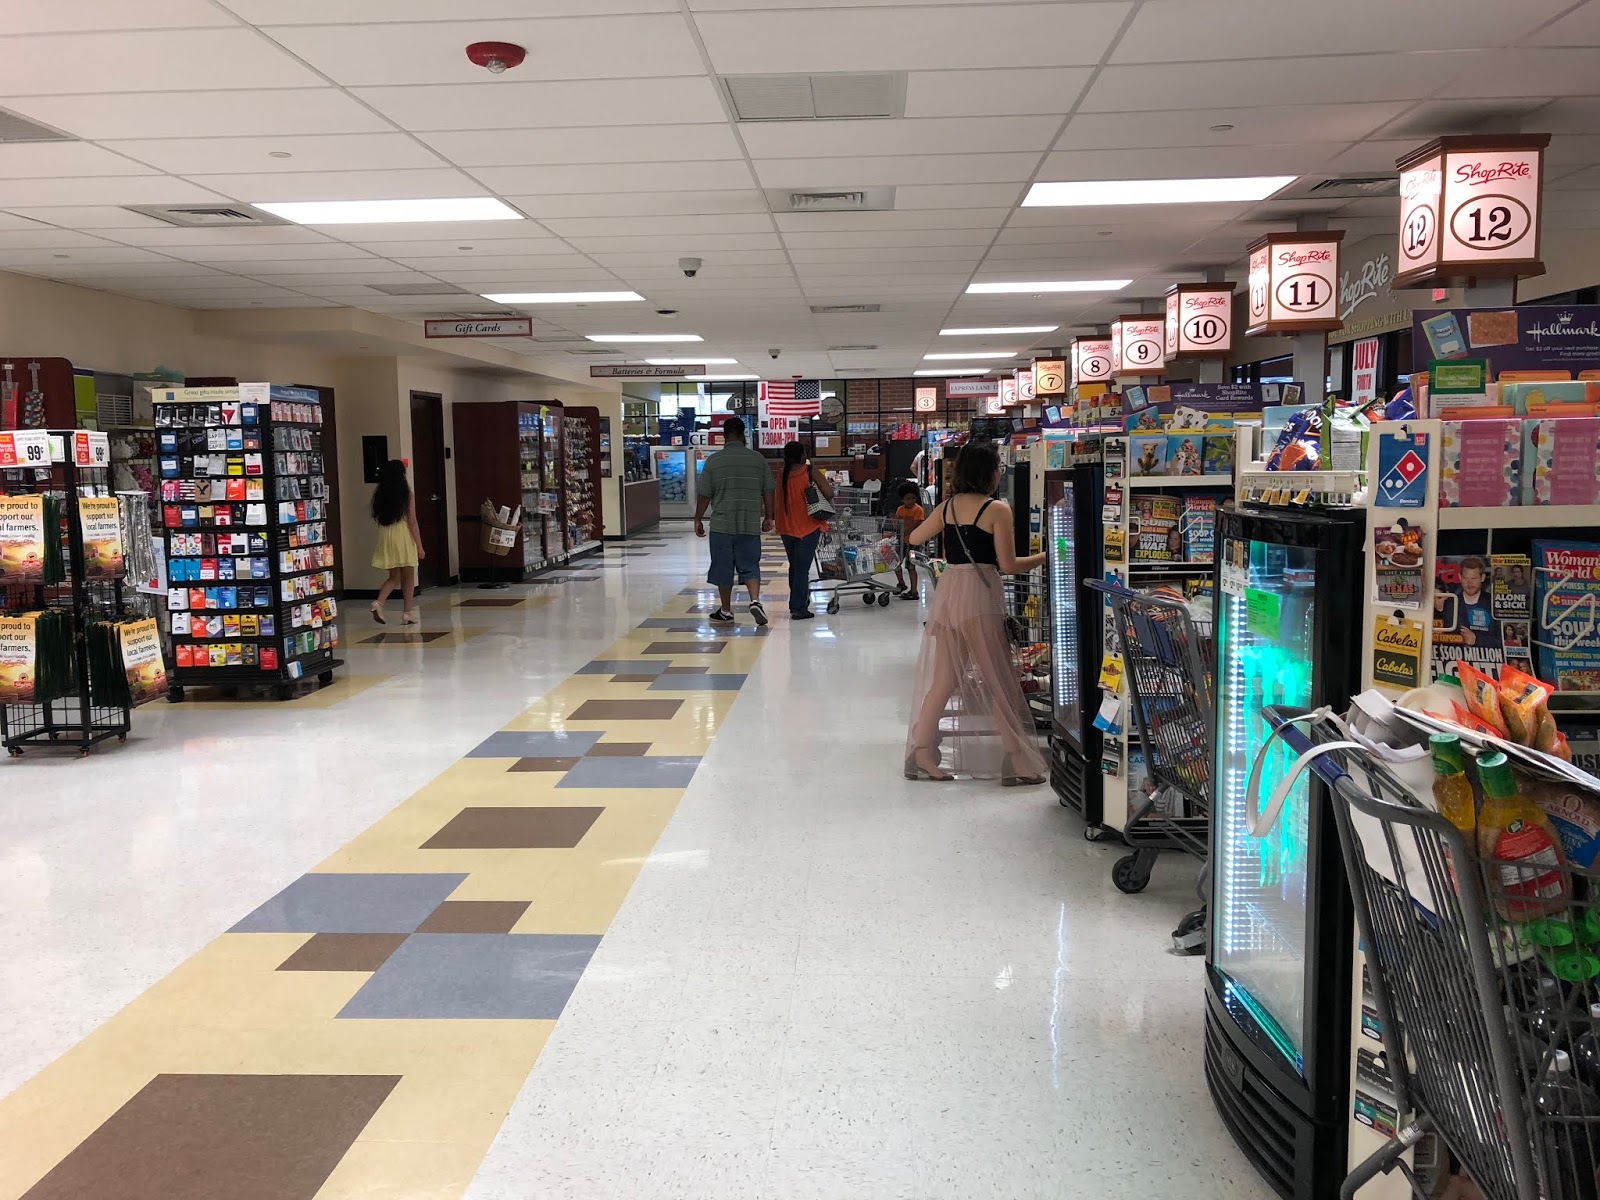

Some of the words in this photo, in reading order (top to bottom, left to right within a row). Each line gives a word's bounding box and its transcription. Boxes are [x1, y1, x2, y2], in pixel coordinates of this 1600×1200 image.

[1454, 162, 1531, 186] ShopRite
[1469, 206, 1512, 241] 12
[1408, 214, 1427, 252] 12
[1278, 250, 1332, 268] ShopRite
[1341, 253, 1389, 319] hopRite
[1255, 286, 1265, 310] 11
[1289, 280, 1320, 306] 11
[1184, 297, 1227, 311] ShopRite
[455, 323, 473, 333] Gift
[475, 323, 501, 332] Cards
[1126, 325, 1160, 337] ShopRite
[1193, 320, 1217, 338] 10
[1525, 321, 1600, 343] Hallmark
[1137, 344, 1149, 360] 9
[1354, 340, 1379, 371] JULY
[612, 367, 644, 375] Batteries
[645, 367, 652, 375] &
[654, 367, 685, 375] Formula
[1090, 360, 1100, 373] 8
[1047, 377, 1056, 388] 7
[1174, 390, 1212, 401] Hallmark
[769, 417, 787, 430] OPEN
[761, 432, 797, 446] 7:30AM-7PM
[6, 502, 29, 510] proud
[95, 502, 110, 510] proud
[1187, 503, 1208, 511] World
[86, 513, 106, 521] support
[6, 523, 39, 531] farmers.
[1188, 529, 1207, 537] SOUP
[1140, 533, 1168, 543] CUSTODY
[1401, 534, 1419, 543] TEXAS
[1140, 542, 1167, 551] WAR
[1135, 549, 1172, 559] EXPLODES!
[1549, 566, 1592, 579] World
[1386, 584, 1415, 593] TEXAS
[1494, 594, 1527, 602] ALONE
[1494, 601, 1502, 609] &
[1502, 601, 1526, 609] SICK!
[1, 623, 22, 631] proud
[123, 627, 136, 636] We're
[136, 624, 150, 634] proud
[1552, 620, 1595, 636] SOUP
[126, 635, 147, 646] support
[1376, 628, 1419, 648] Cabela's
[1554, 636, 1574, 647] this
[2, 644, 31, 652] farmers.
[126, 648, 139, 657] local
[1463, 646, 1503, 662] MILLION
[1376, 657, 1414, 676] Cabela's
[1547, 803, 1590, 826] ARNOLD
